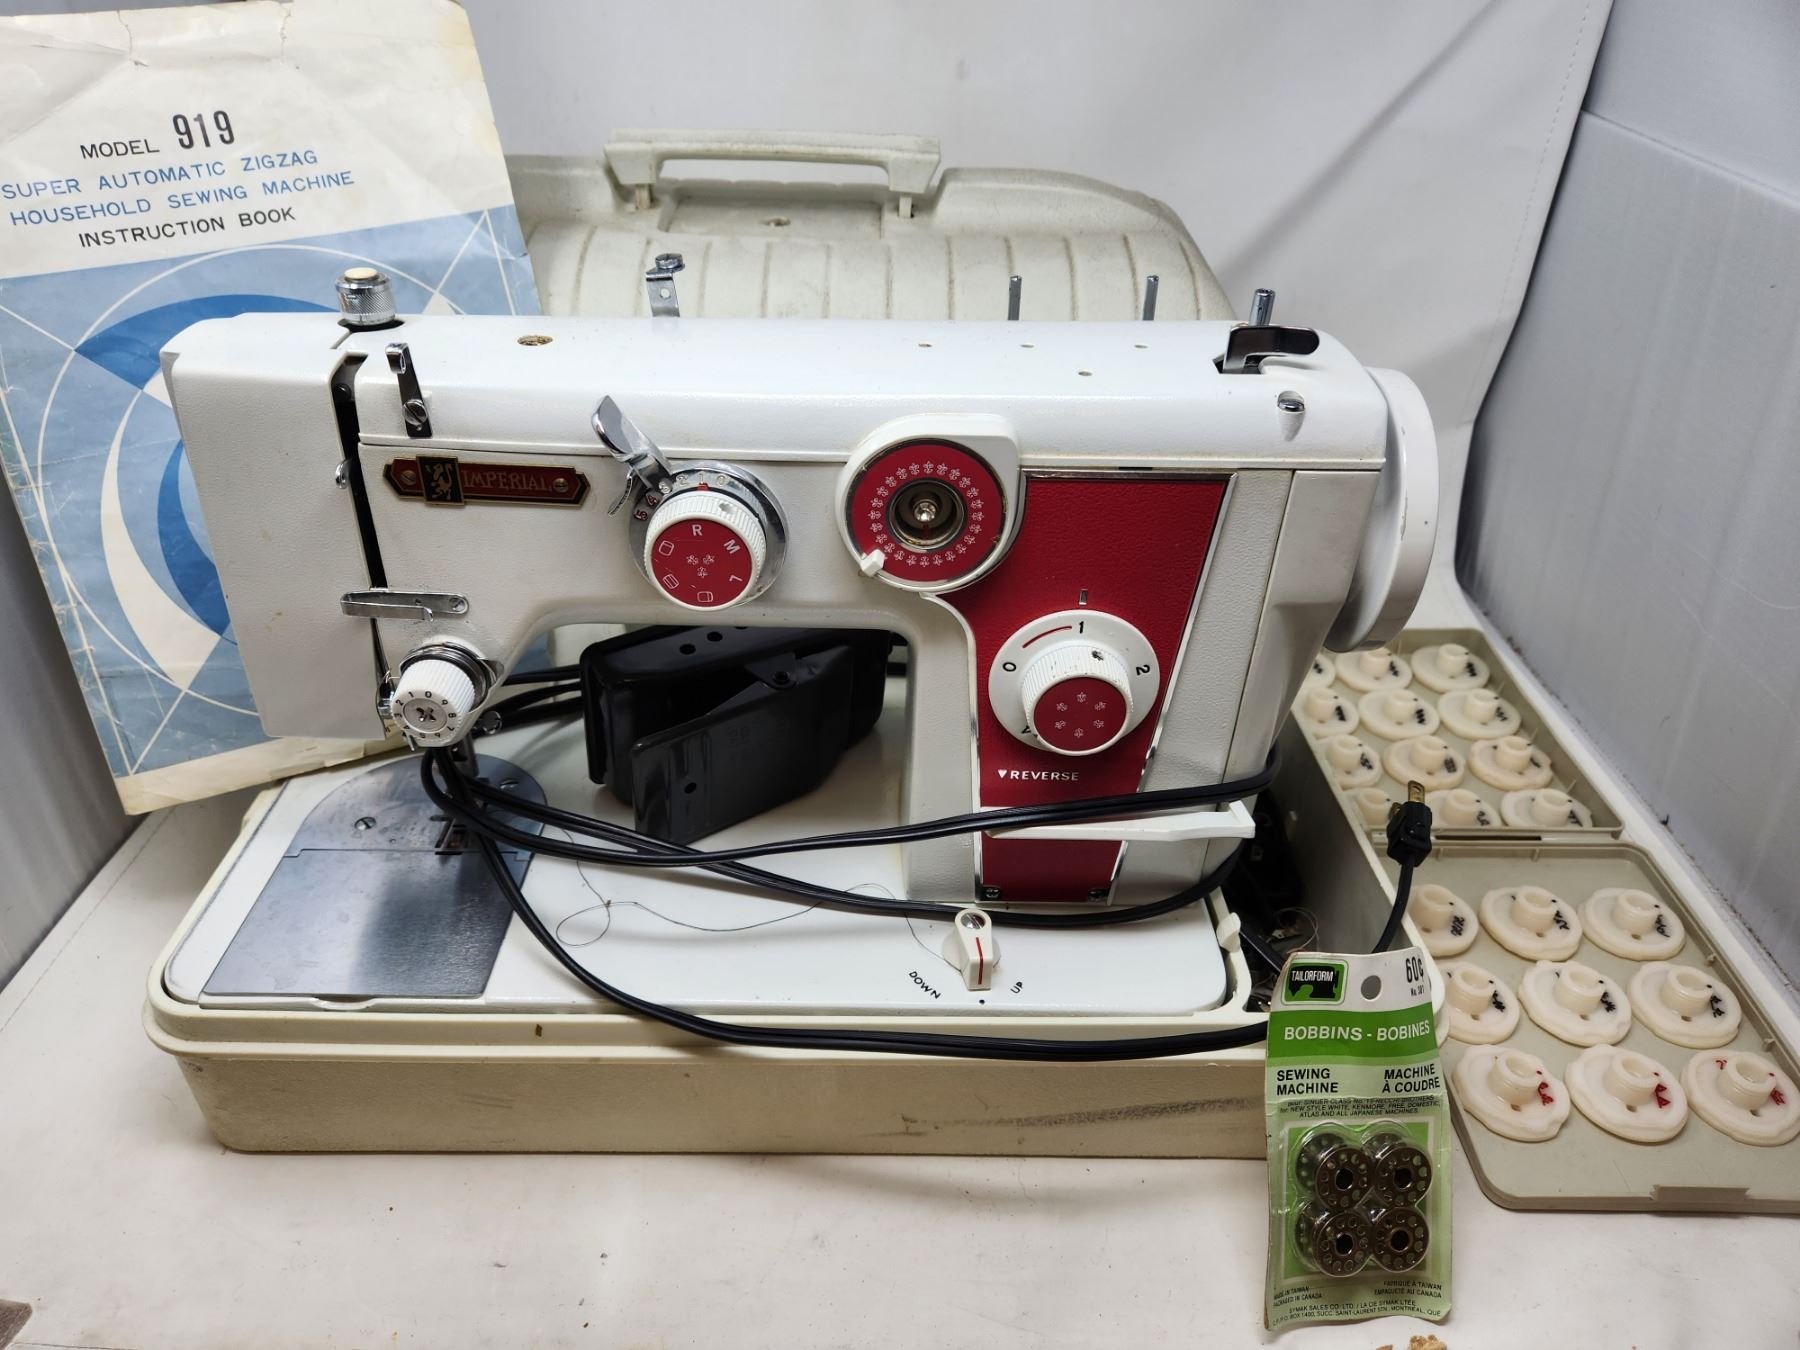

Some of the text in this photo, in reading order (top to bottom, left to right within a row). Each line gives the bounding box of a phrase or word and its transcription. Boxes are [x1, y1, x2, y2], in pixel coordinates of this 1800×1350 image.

[80, 110, 235, 159] MODEL 919
[1, 150, 318, 200] SUPER AUTOMATIC ZIGZAG
[10, 170, 355, 226] HOUSEHOLD SEWING MACHINE
[78, 207, 296, 247] INSTRUCTION BOOK
[461, 469, 552, 492] IMPERIAL
[691, 524, 703, 537] R
[723, 539, 741, 554] M
[1078, 621, 1085, 634] 1
[1135, 664, 1151, 676] 2
[1010, 769, 1079, 781] REVERSE
[1291, 970, 1334, 982] TAILORFORM
[908, 971, 941, 999] DOWN
[1010, 981, 1023, 994] UP
[1284, 1026, 1362, 1041] BOBBINS
[1377, 1020, 1430, 1041] BOBINES
[1276, 1068, 1331, 1082] SEWING
[1384, 1063, 1436, 1080] MACHINE
[1276, 1082, 1339, 1096] MACHINE
[1382, 1077, 1440, 1093] À COUDRE
[1417, 1290, 1441, 1298] CANADA
